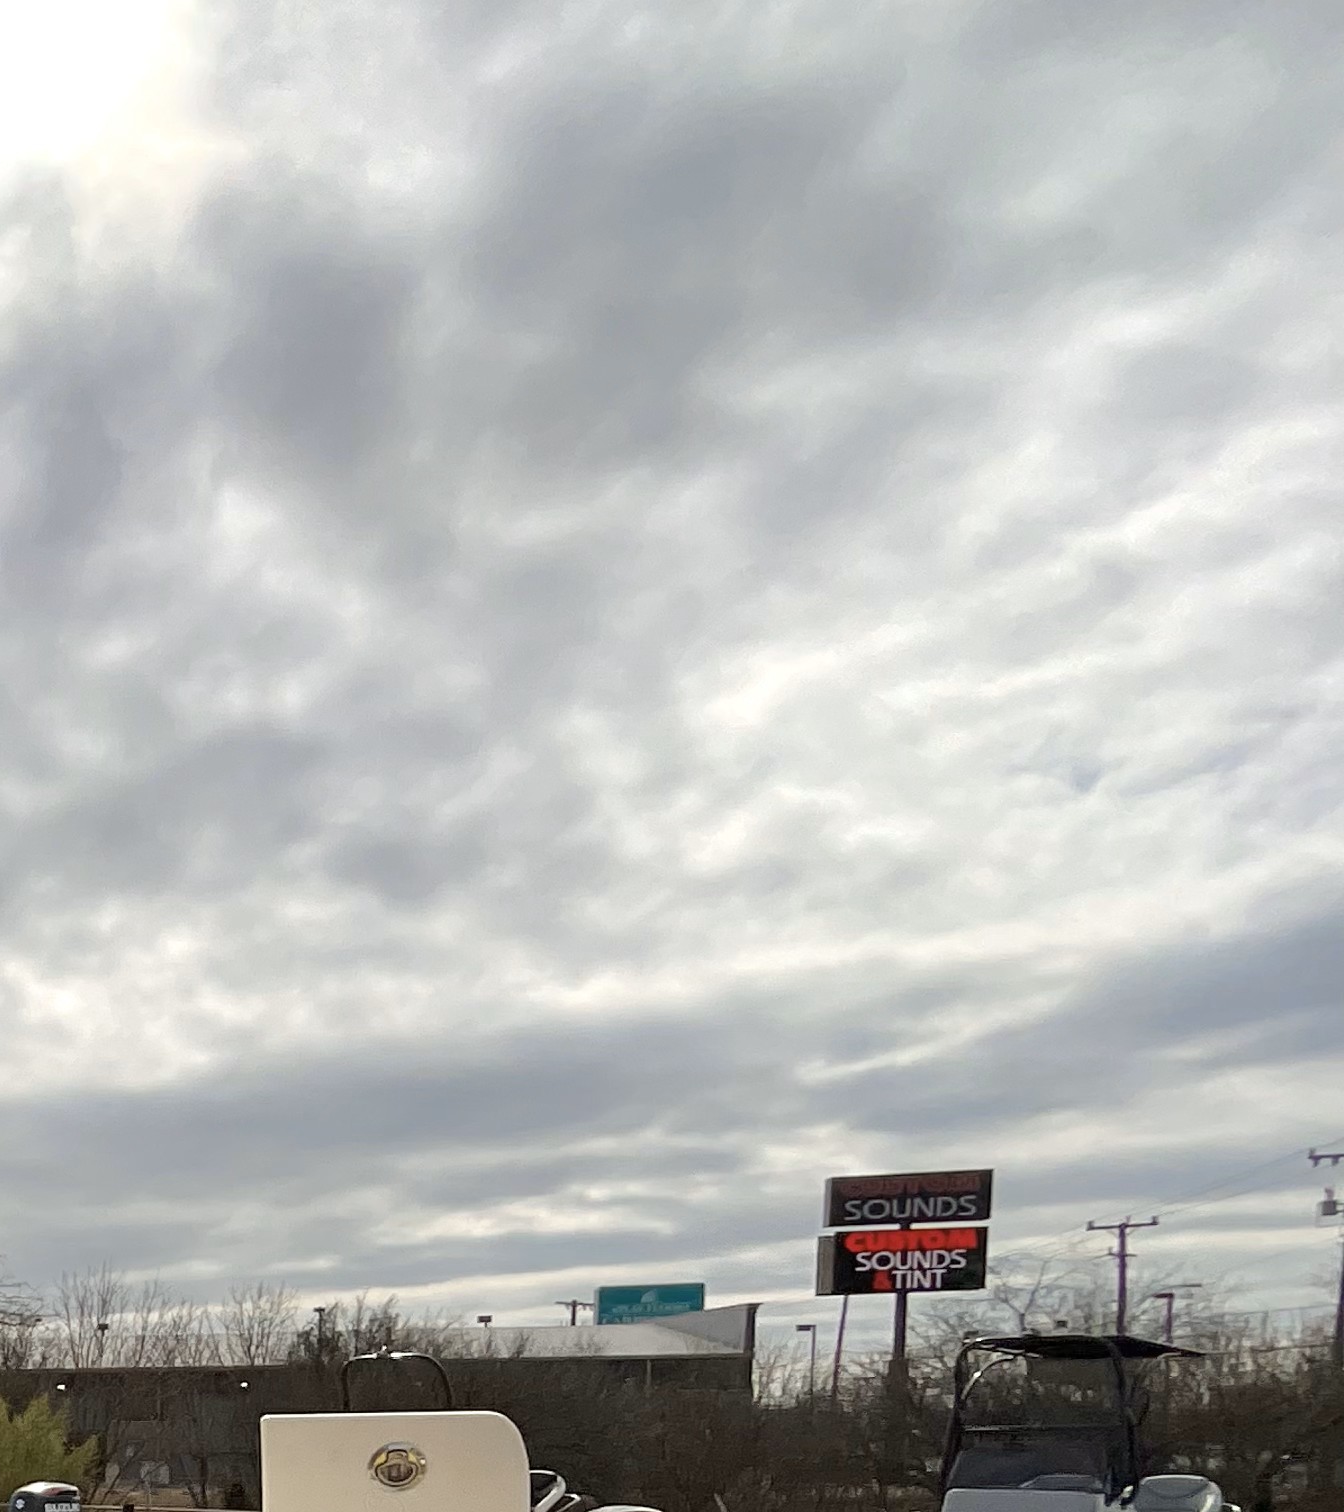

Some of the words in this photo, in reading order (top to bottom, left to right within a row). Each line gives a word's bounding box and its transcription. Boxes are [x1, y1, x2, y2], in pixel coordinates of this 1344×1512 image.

[844, 1195, 977, 1220] SOUNDS
[844, 1228, 978, 1252] CUSTOM
[855, 1249, 968, 1271] SOUNDS
[892, 1268, 948, 1289] TINT
